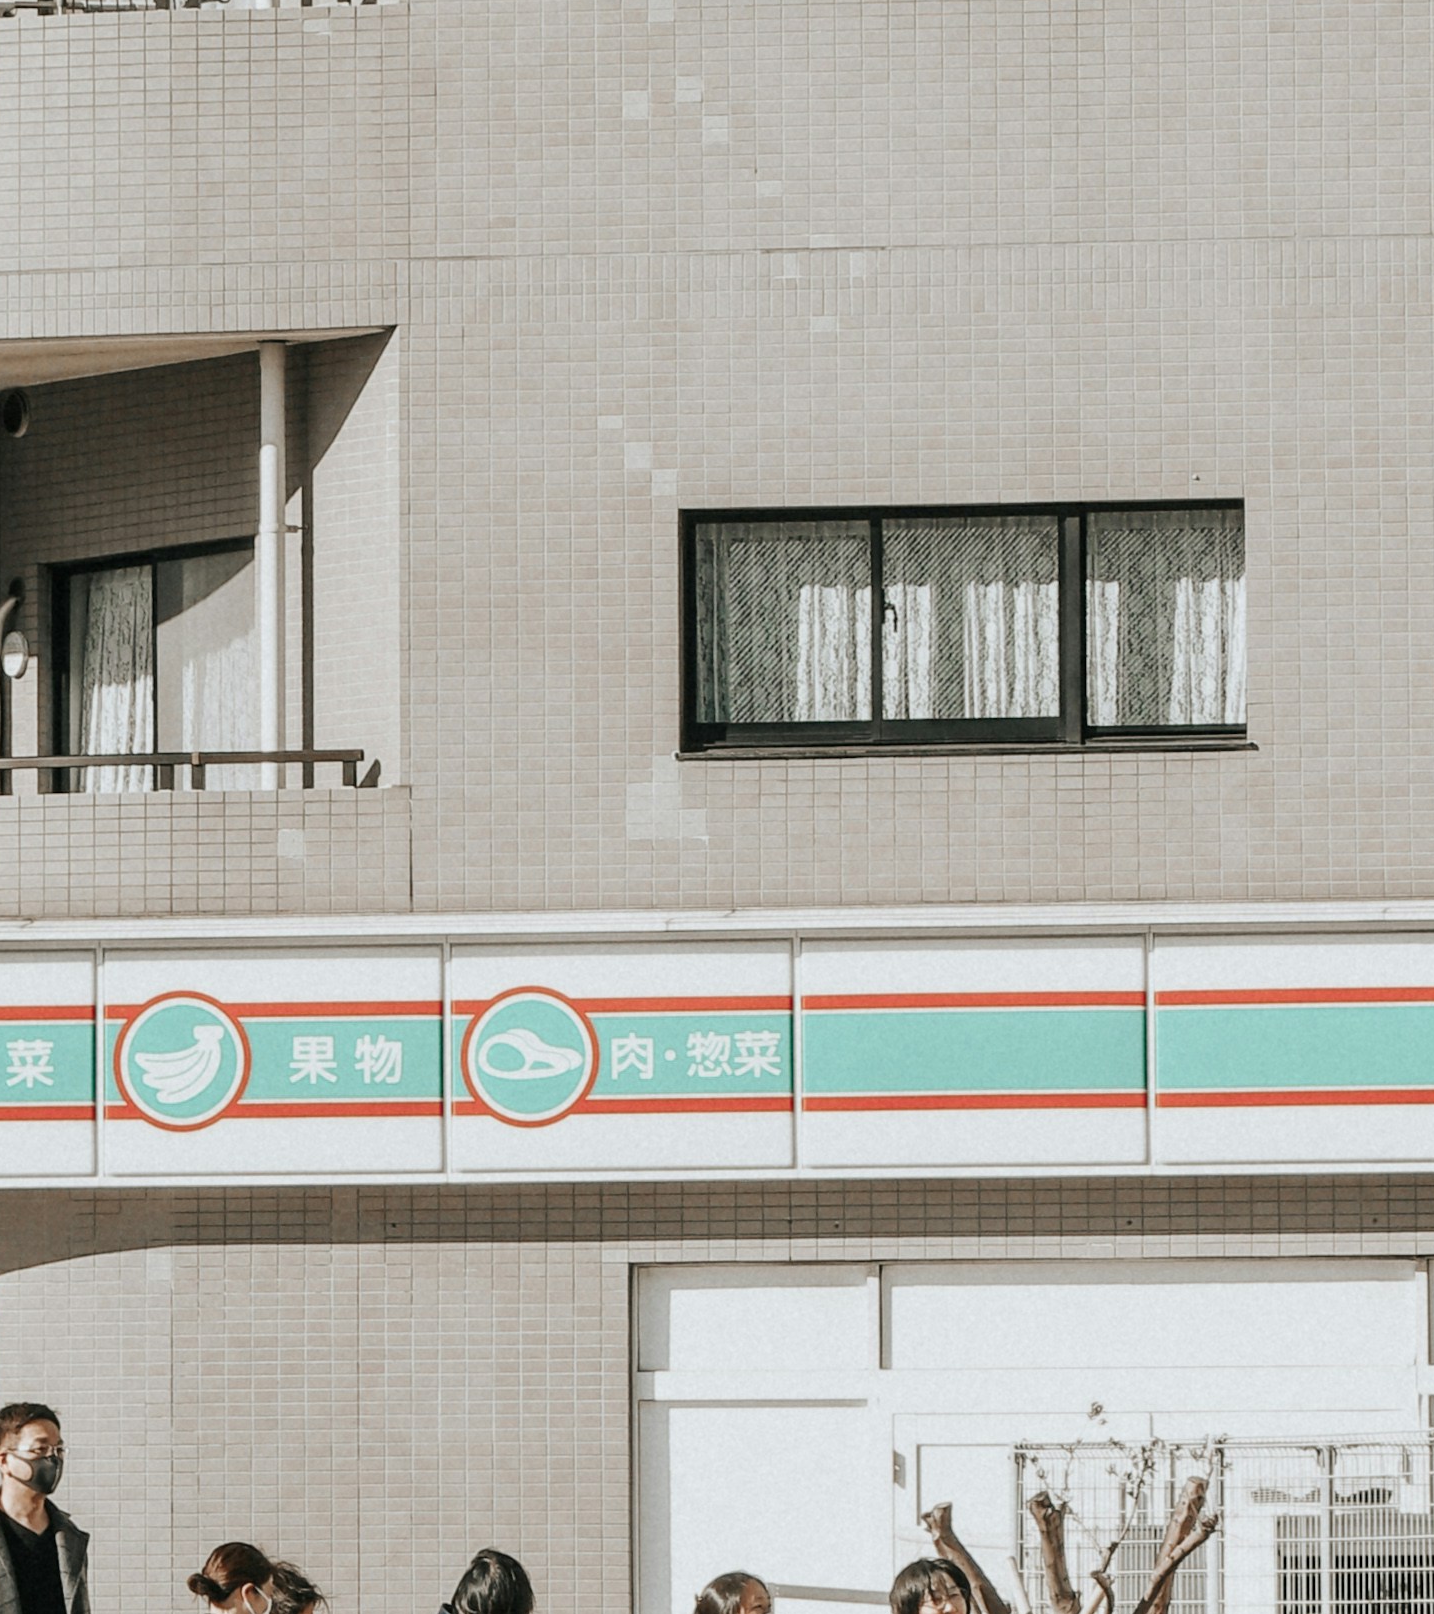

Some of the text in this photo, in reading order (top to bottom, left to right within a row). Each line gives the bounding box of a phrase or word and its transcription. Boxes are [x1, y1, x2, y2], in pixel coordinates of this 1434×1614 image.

[287, 1033, 407, 1087] 果物
[607, 1028, 783, 1081] 肉・惣菜
